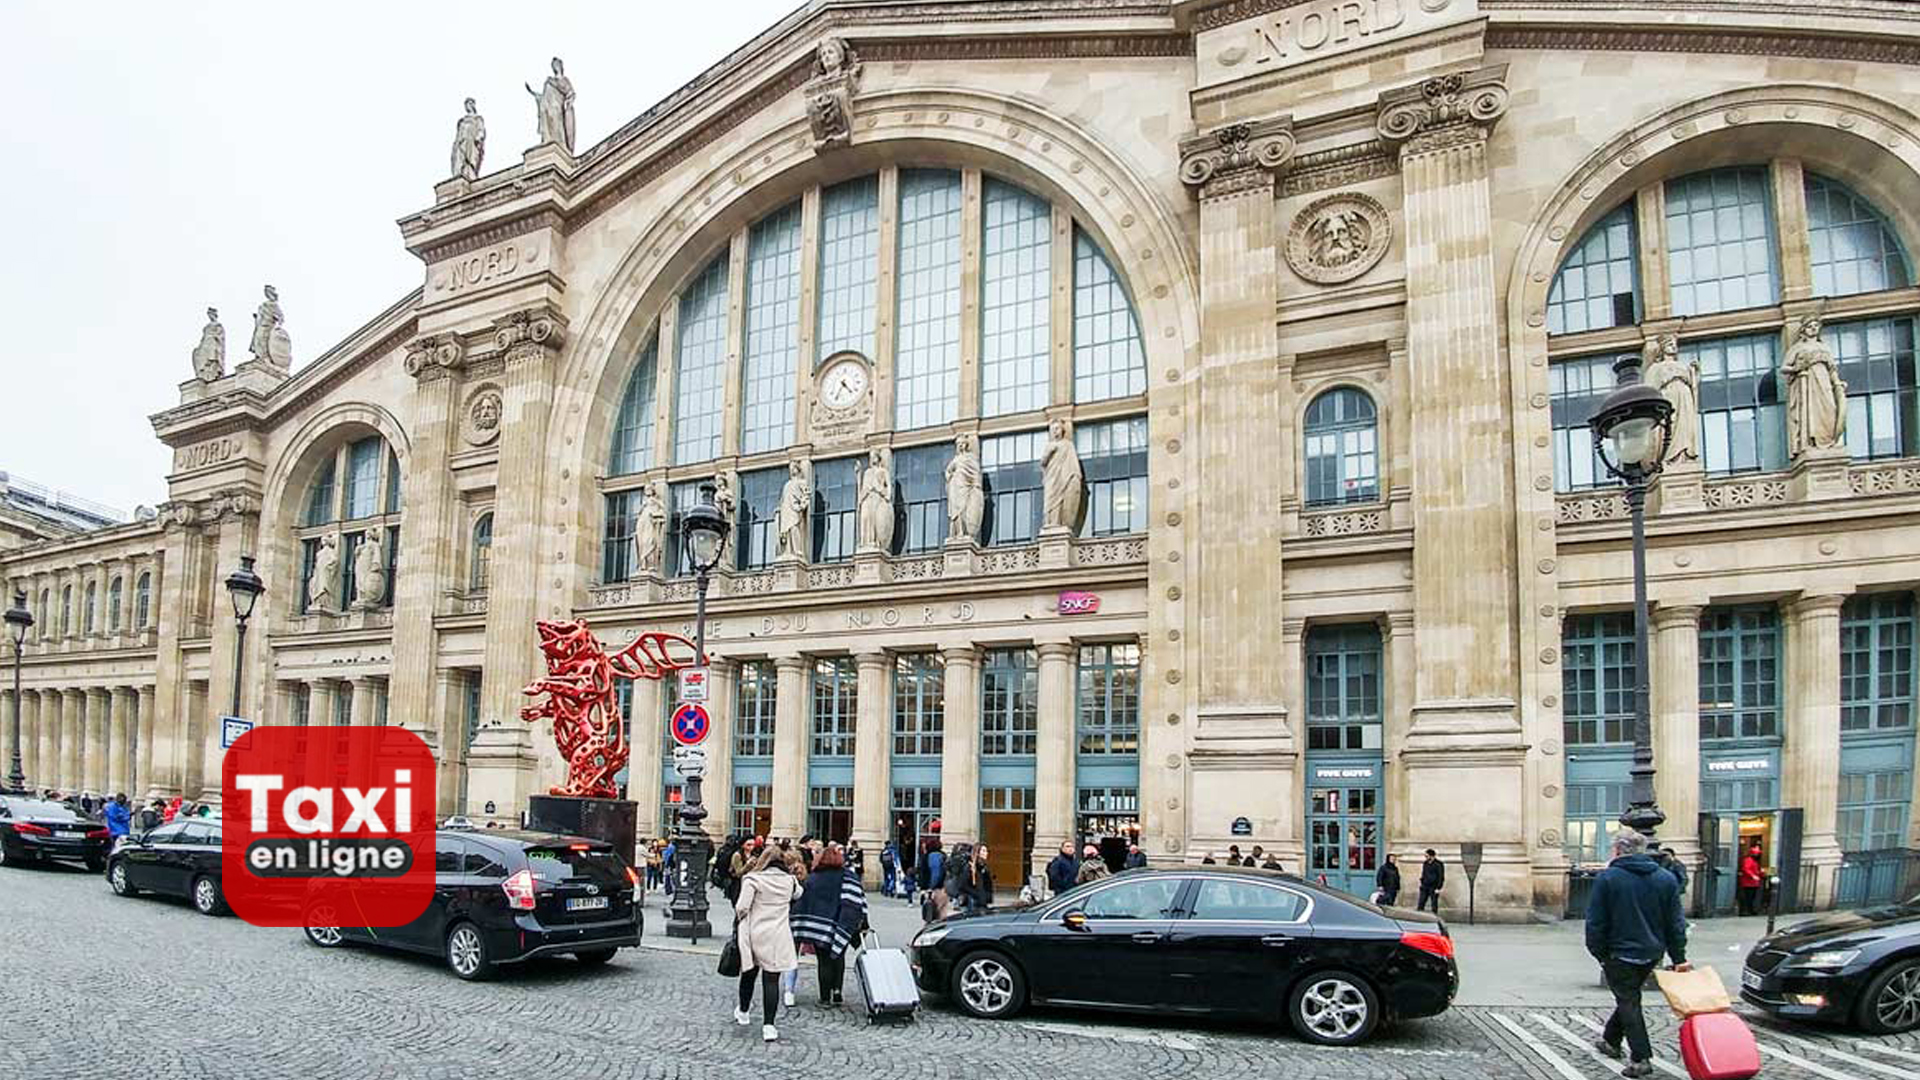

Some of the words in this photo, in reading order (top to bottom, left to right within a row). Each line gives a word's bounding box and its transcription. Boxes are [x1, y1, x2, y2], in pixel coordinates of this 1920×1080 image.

[1252, 0, 1405, 64] NORD
[449, 246, 519, 291] NORD
[185, 439, 232, 469] NORD
[761, 615, 808, 634] DU
[847, 602, 975, 629] NORD
[1060, 598, 1096, 611] SNCF
